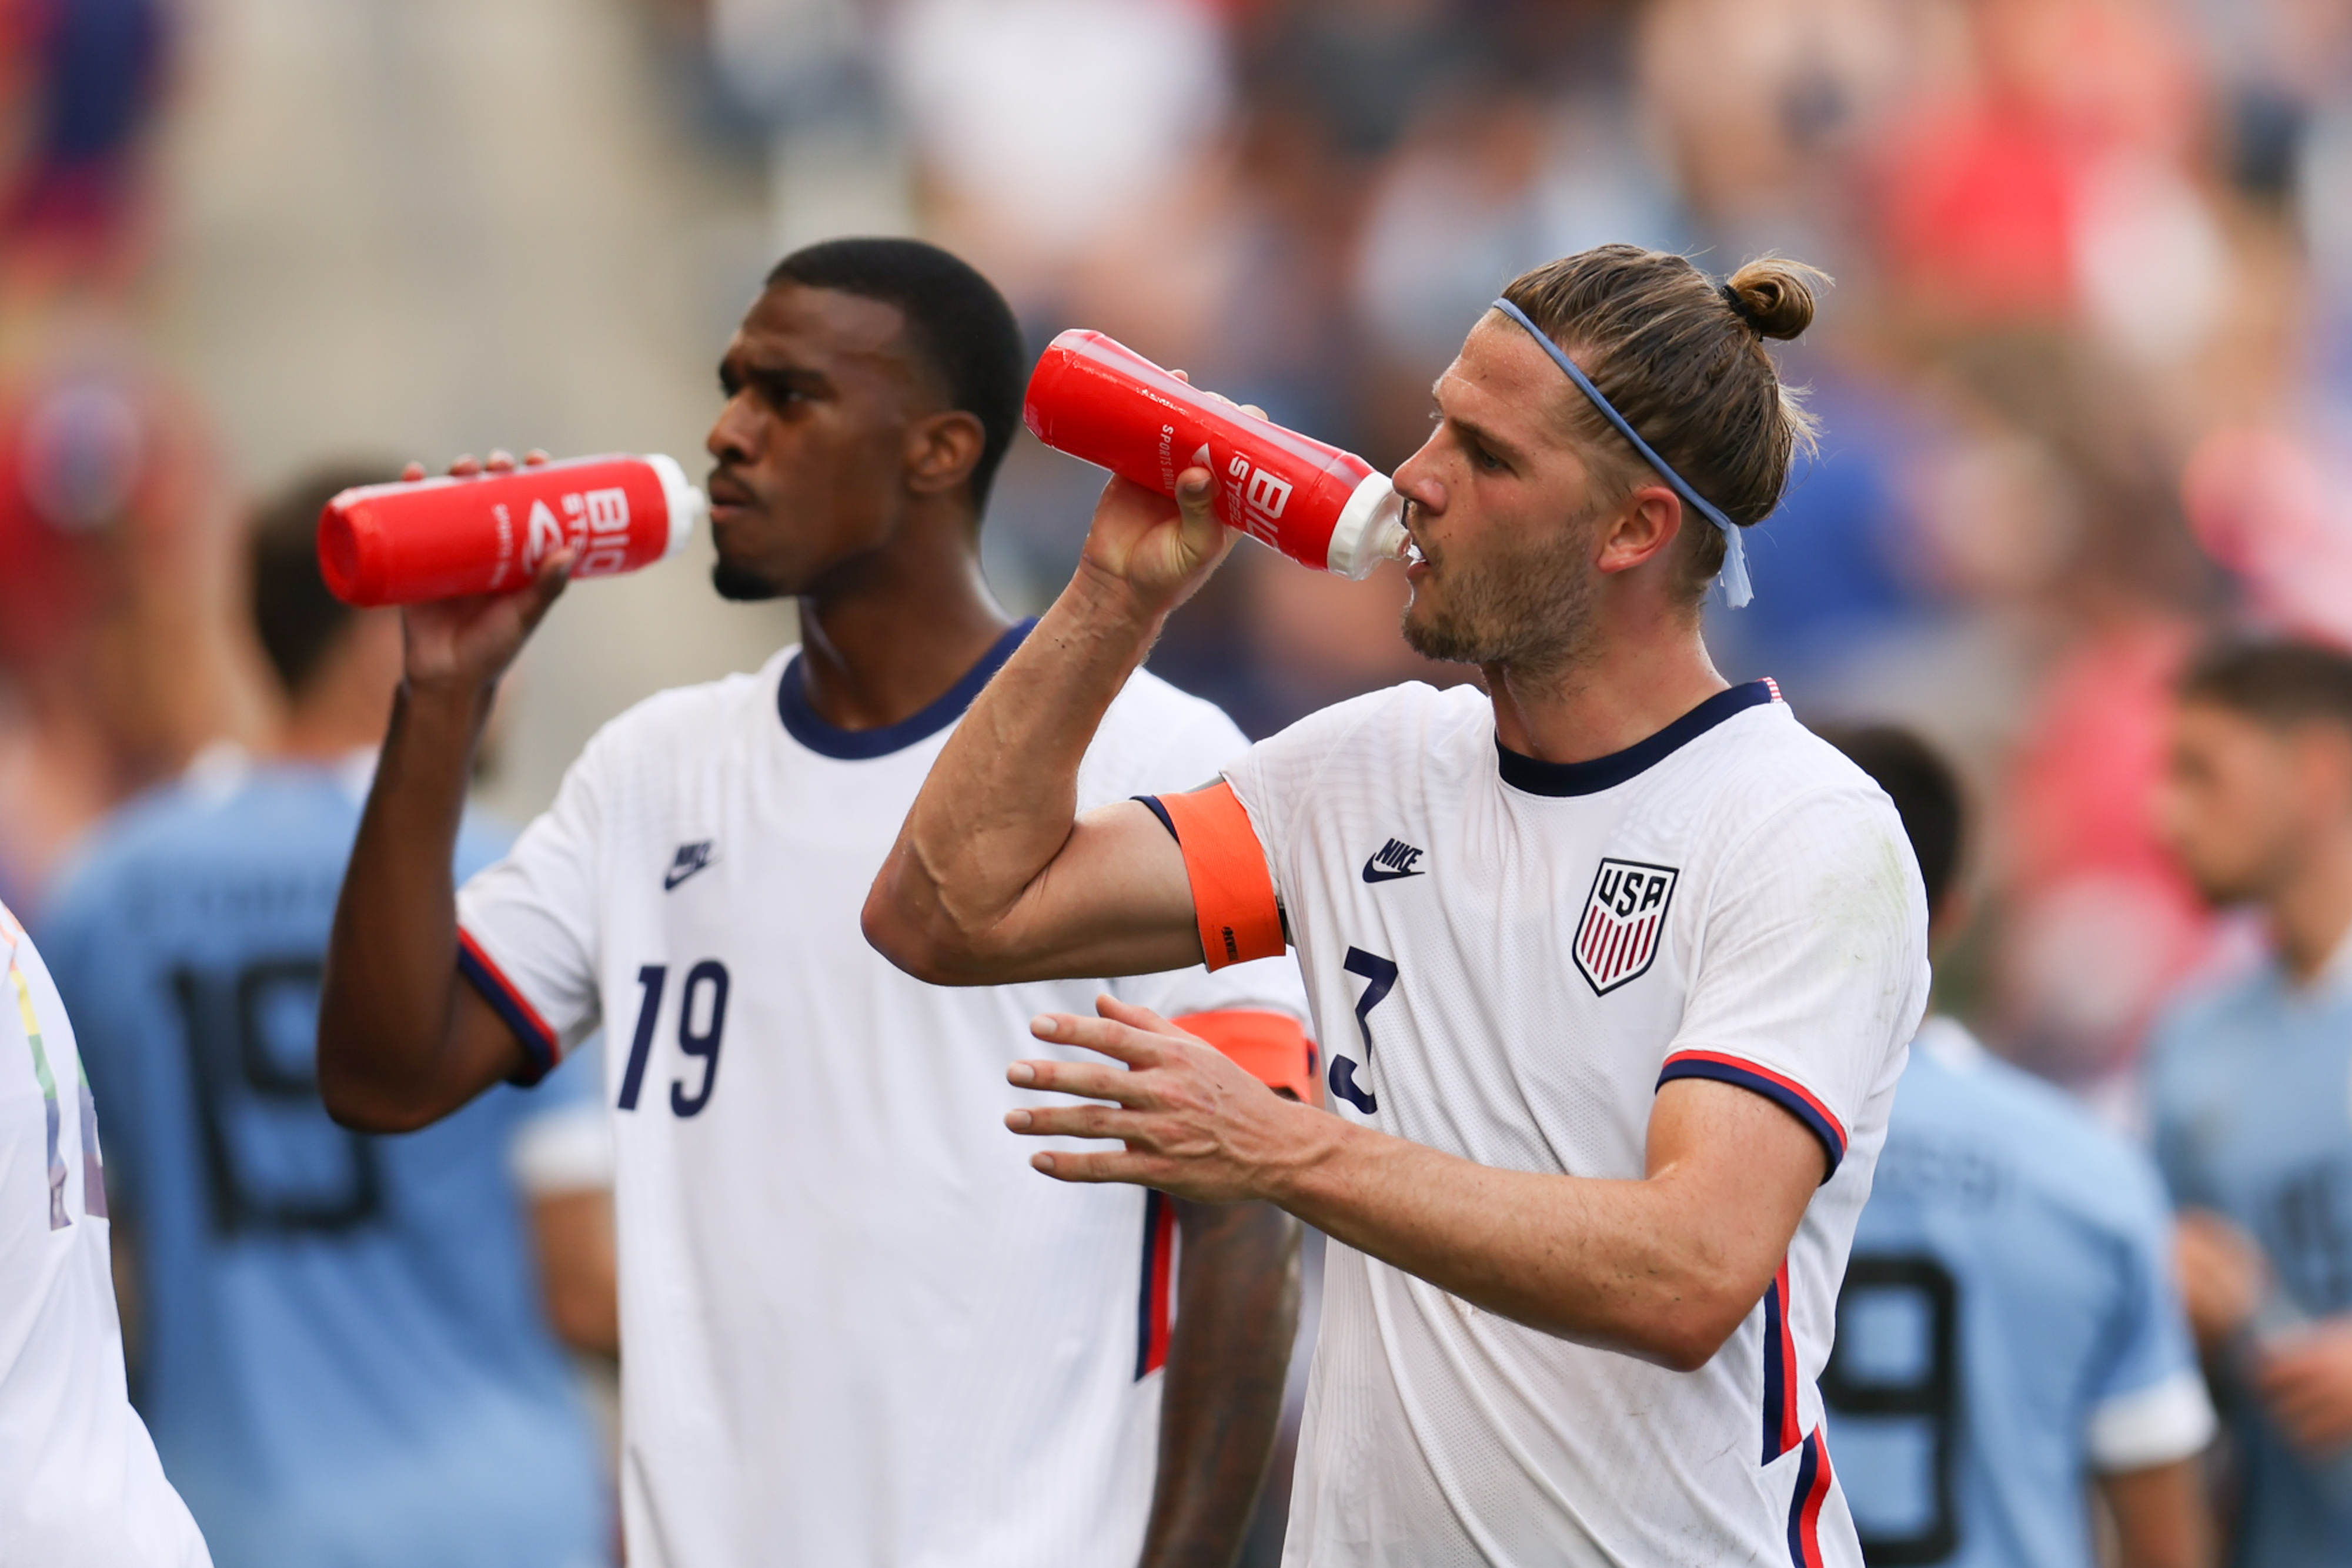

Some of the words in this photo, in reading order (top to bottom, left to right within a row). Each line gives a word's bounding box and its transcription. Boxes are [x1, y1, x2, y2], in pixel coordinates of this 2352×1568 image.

[1159, 424, 1174, 466] SPORTS
[1375, 838, 1424, 872] NIKE
[1598, 869, 1667, 918] USA
[617, 959, 729, 1117] 19
[1329, 945, 1399, 1115] 3
[1822, 1252, 1959, 1566] 9
